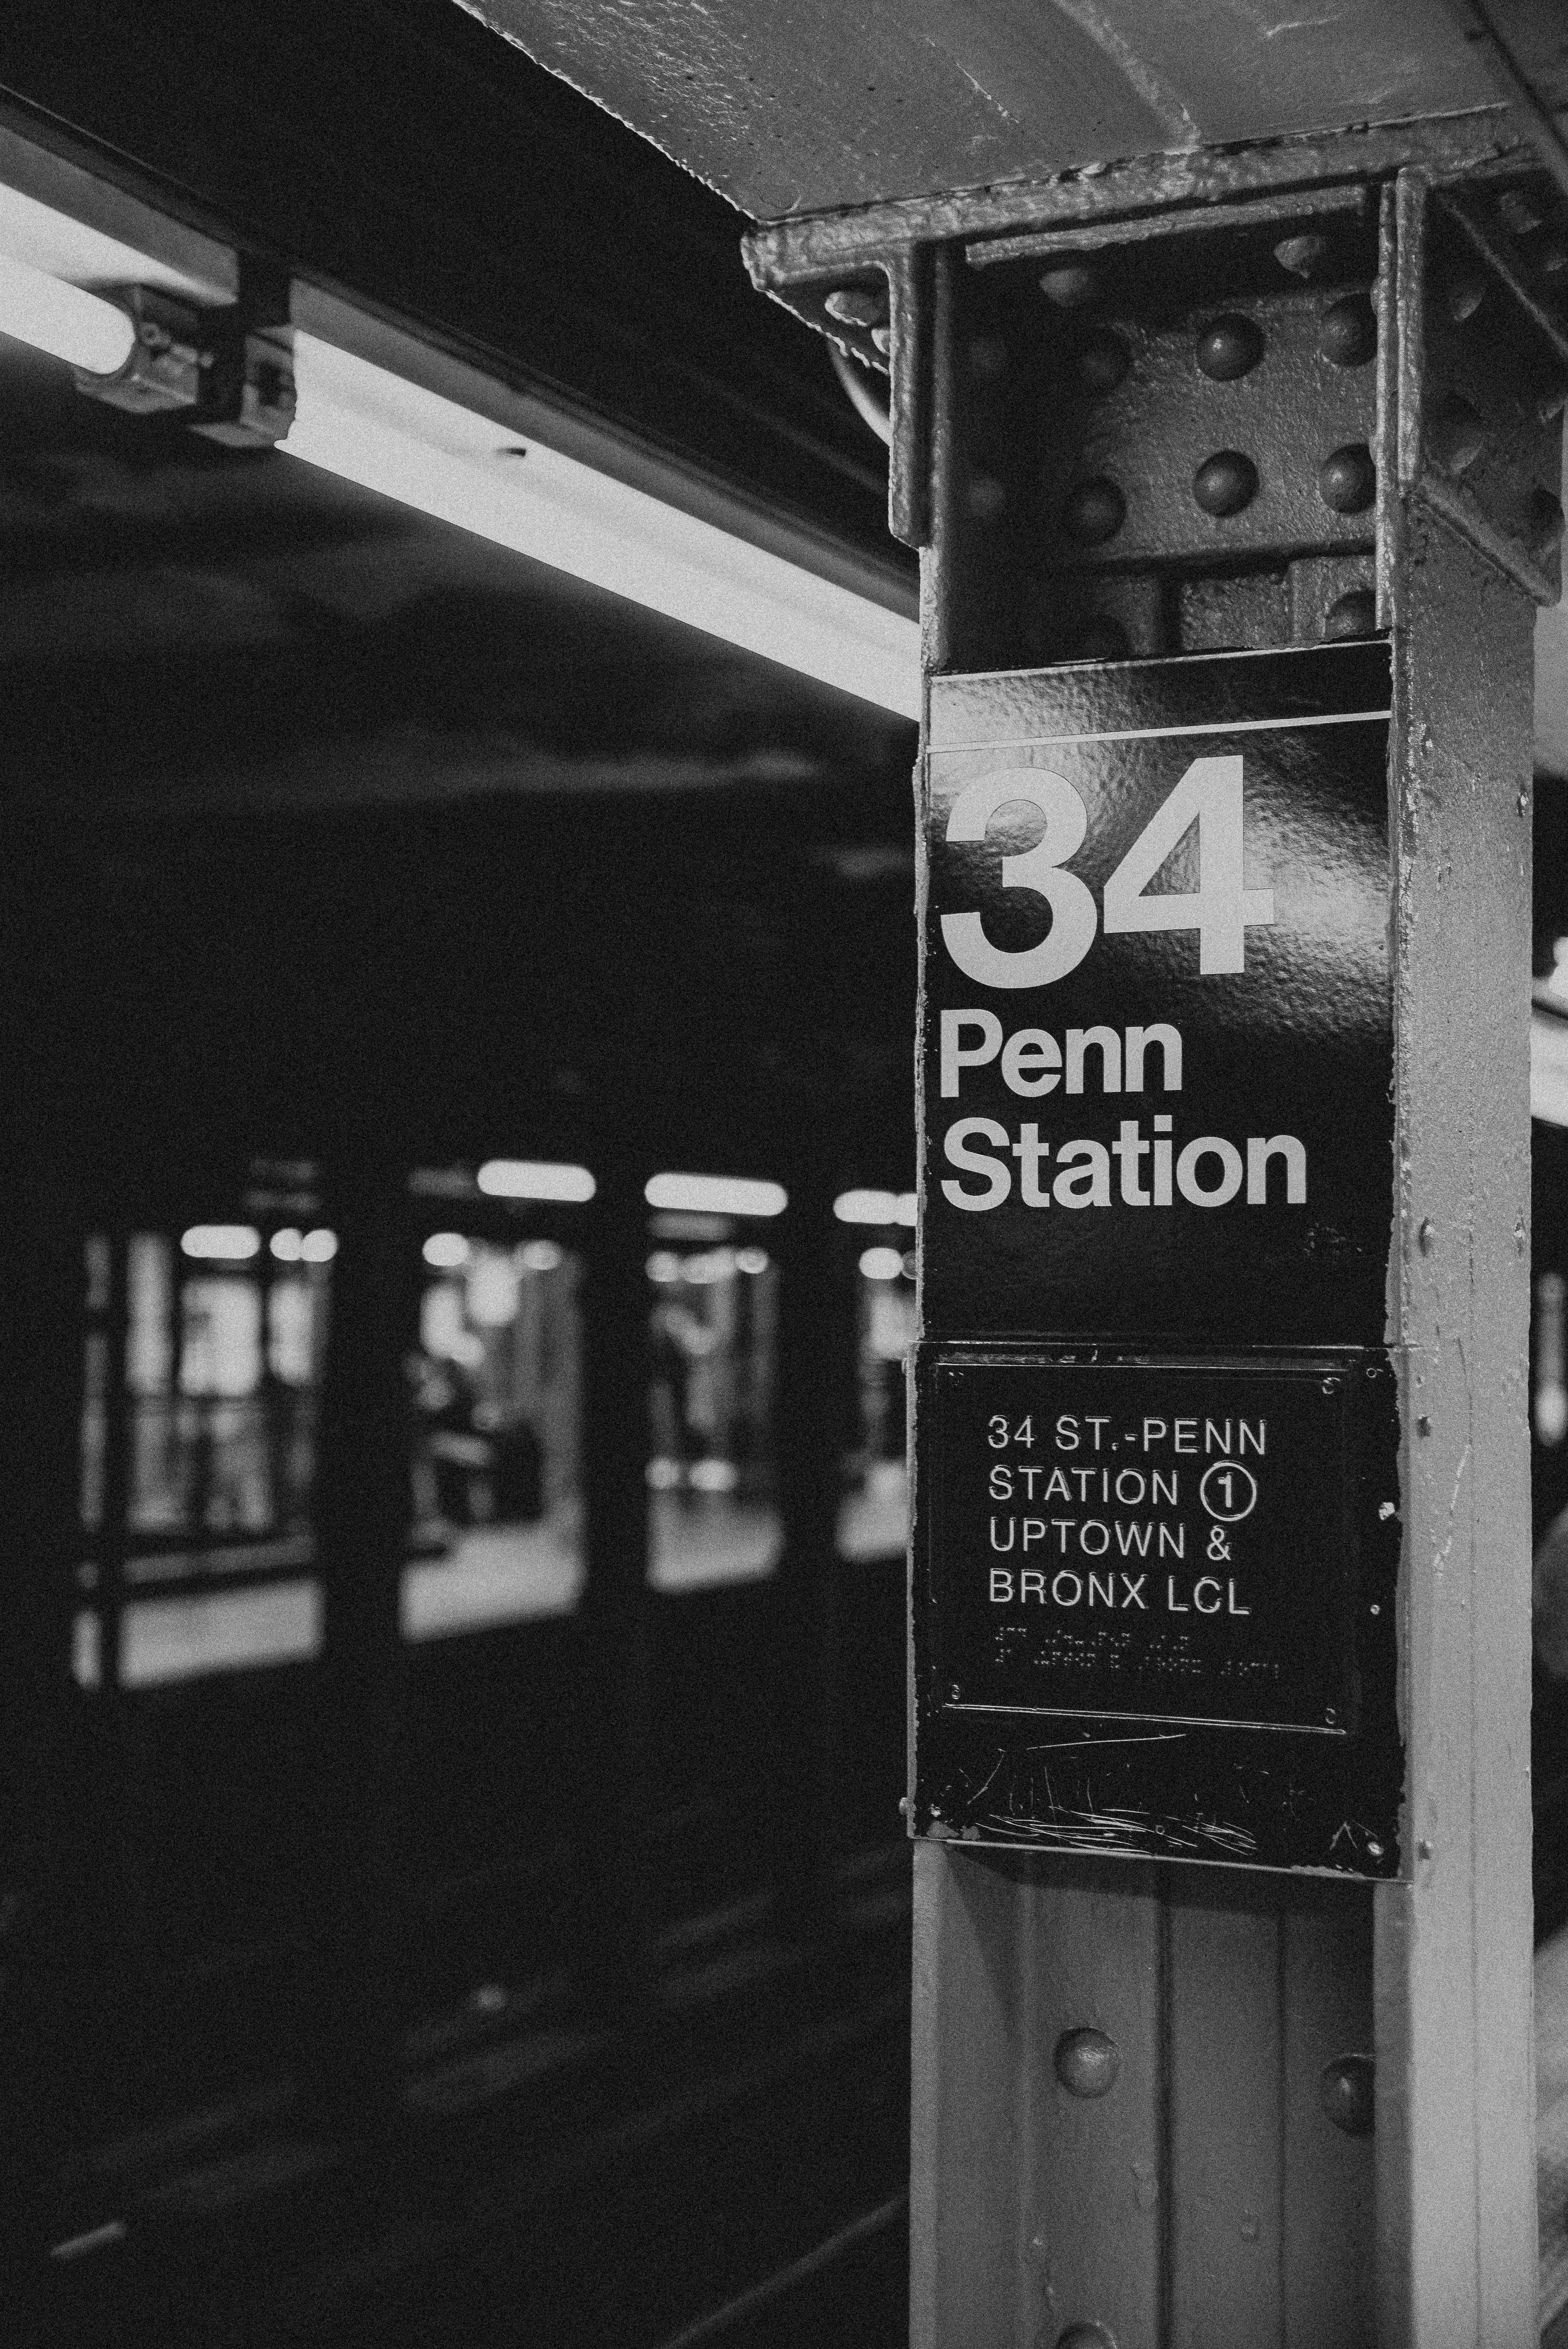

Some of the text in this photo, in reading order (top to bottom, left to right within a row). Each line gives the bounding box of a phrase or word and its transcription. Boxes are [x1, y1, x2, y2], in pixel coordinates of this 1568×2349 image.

[940, 755, 1274, 989] 34
[940, 1008, 1183, 1098] Penn
[940, 1114, 1307, 1212] Station
[988, 1415, 1266, 1455] 34 ST.-PENN
[989, 1464, 1179, 1505] STATION
[989, 1517, 1232, 1561] UPTOWN &
[989, 1568, 1250, 1615] BRONX LCL
